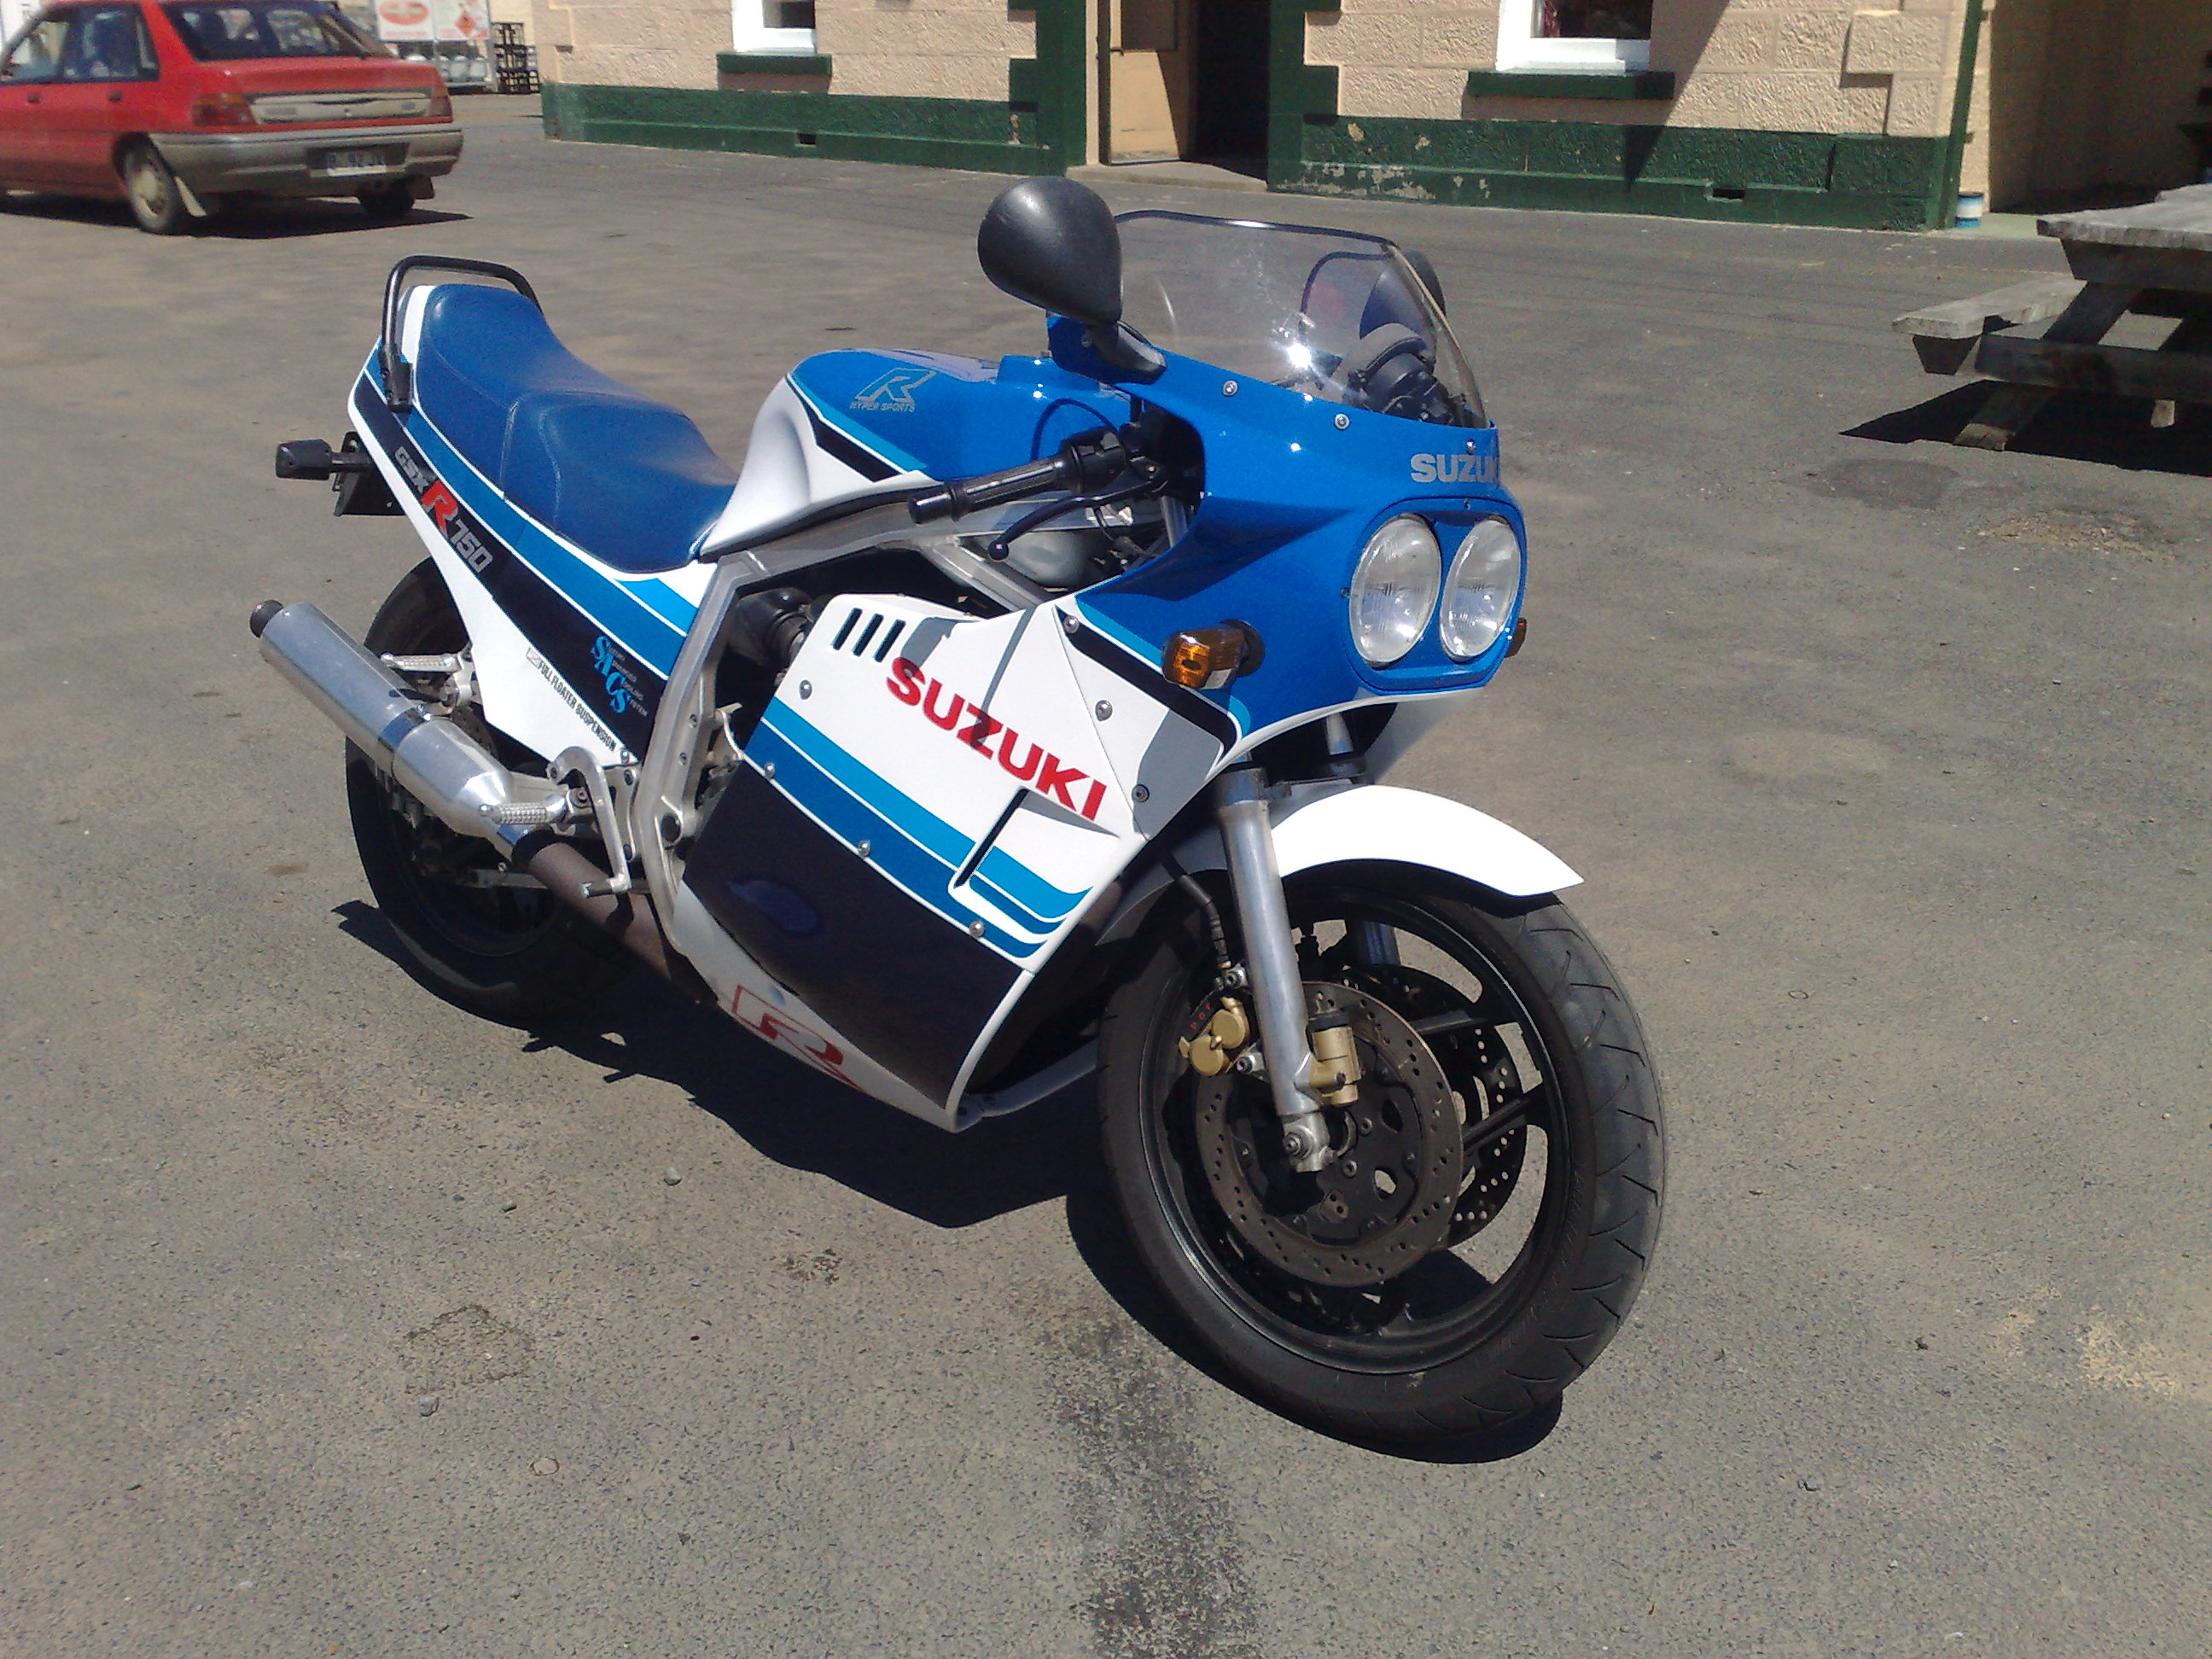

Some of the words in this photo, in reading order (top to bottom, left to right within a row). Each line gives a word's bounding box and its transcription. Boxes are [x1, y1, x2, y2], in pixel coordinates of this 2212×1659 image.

[849, 401, 879, 411] HYPER
[881, 402, 916, 413] SPORTS
[537, 659, 553, 683] FULL
[550, 674, 578, 709] FLOATER
[575, 702, 617, 752] SUSPENSION
[886, 656, 1108, 821] SUZUKI
